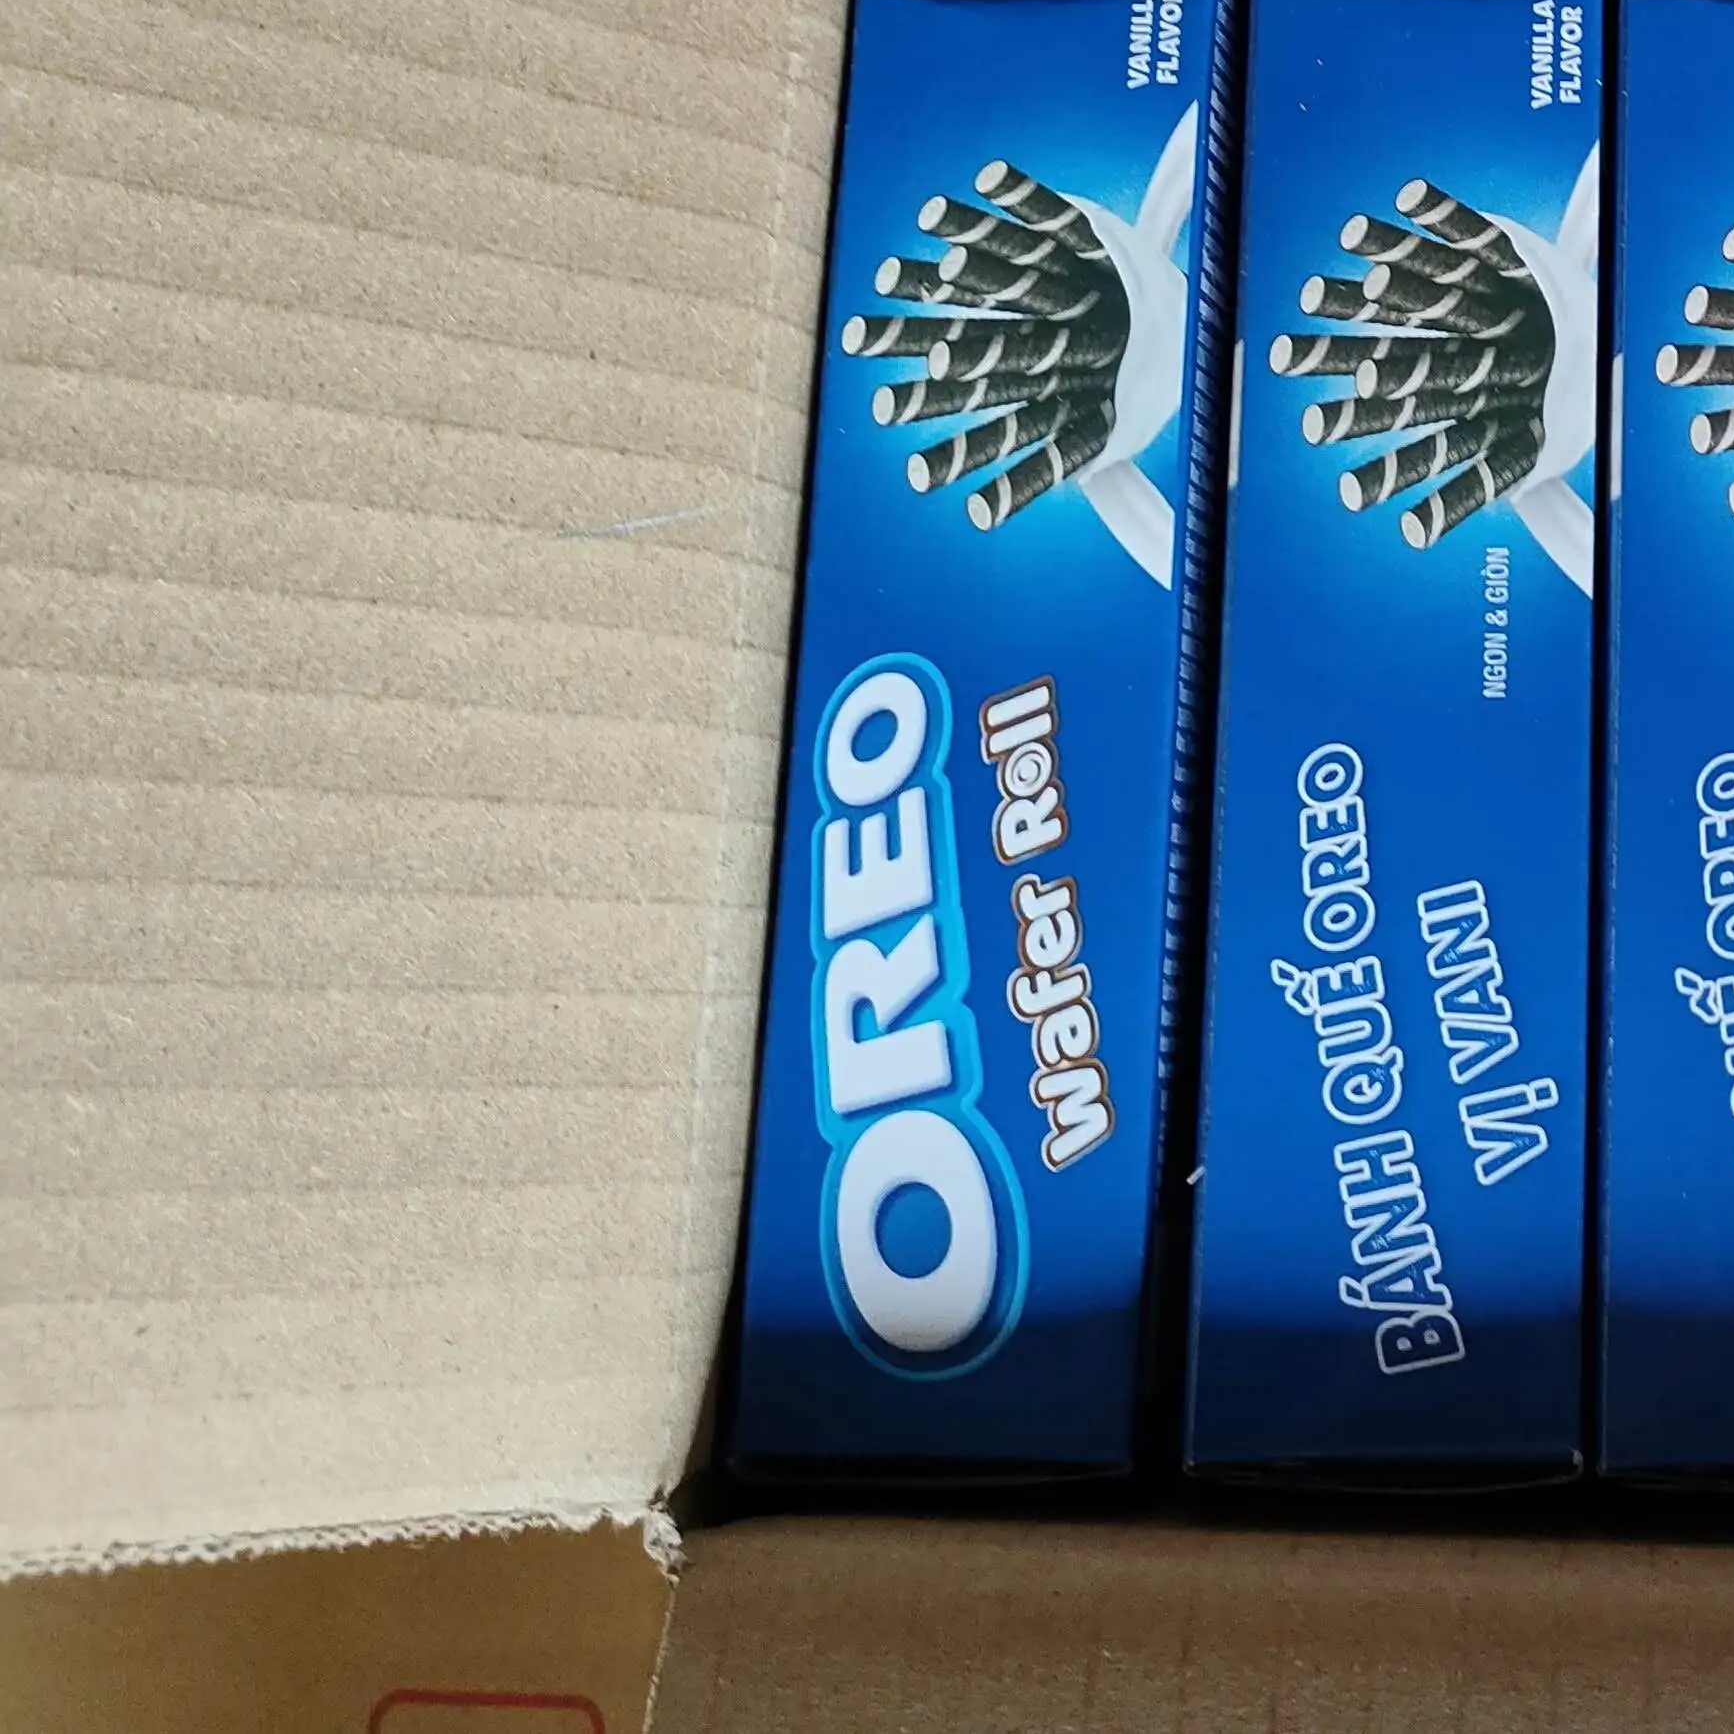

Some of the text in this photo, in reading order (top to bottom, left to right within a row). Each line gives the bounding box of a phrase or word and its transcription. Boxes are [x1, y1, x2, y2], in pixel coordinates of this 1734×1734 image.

[1530, 0, 1556, 109] VANILLA
[1559, 6, 1584, 104] FLAVOR
[1482, 632, 1509, 699] NGON
[1484, 608, 1509, 627] &
[822, 668, 1000, 1355] OREO
[977, 675, 1116, 1174] Wafer Roll
[1270, 743, 1466, 1375] BÁNH QUẾ OREO
[1416, 879, 1560, 1187] VỊ VANI
